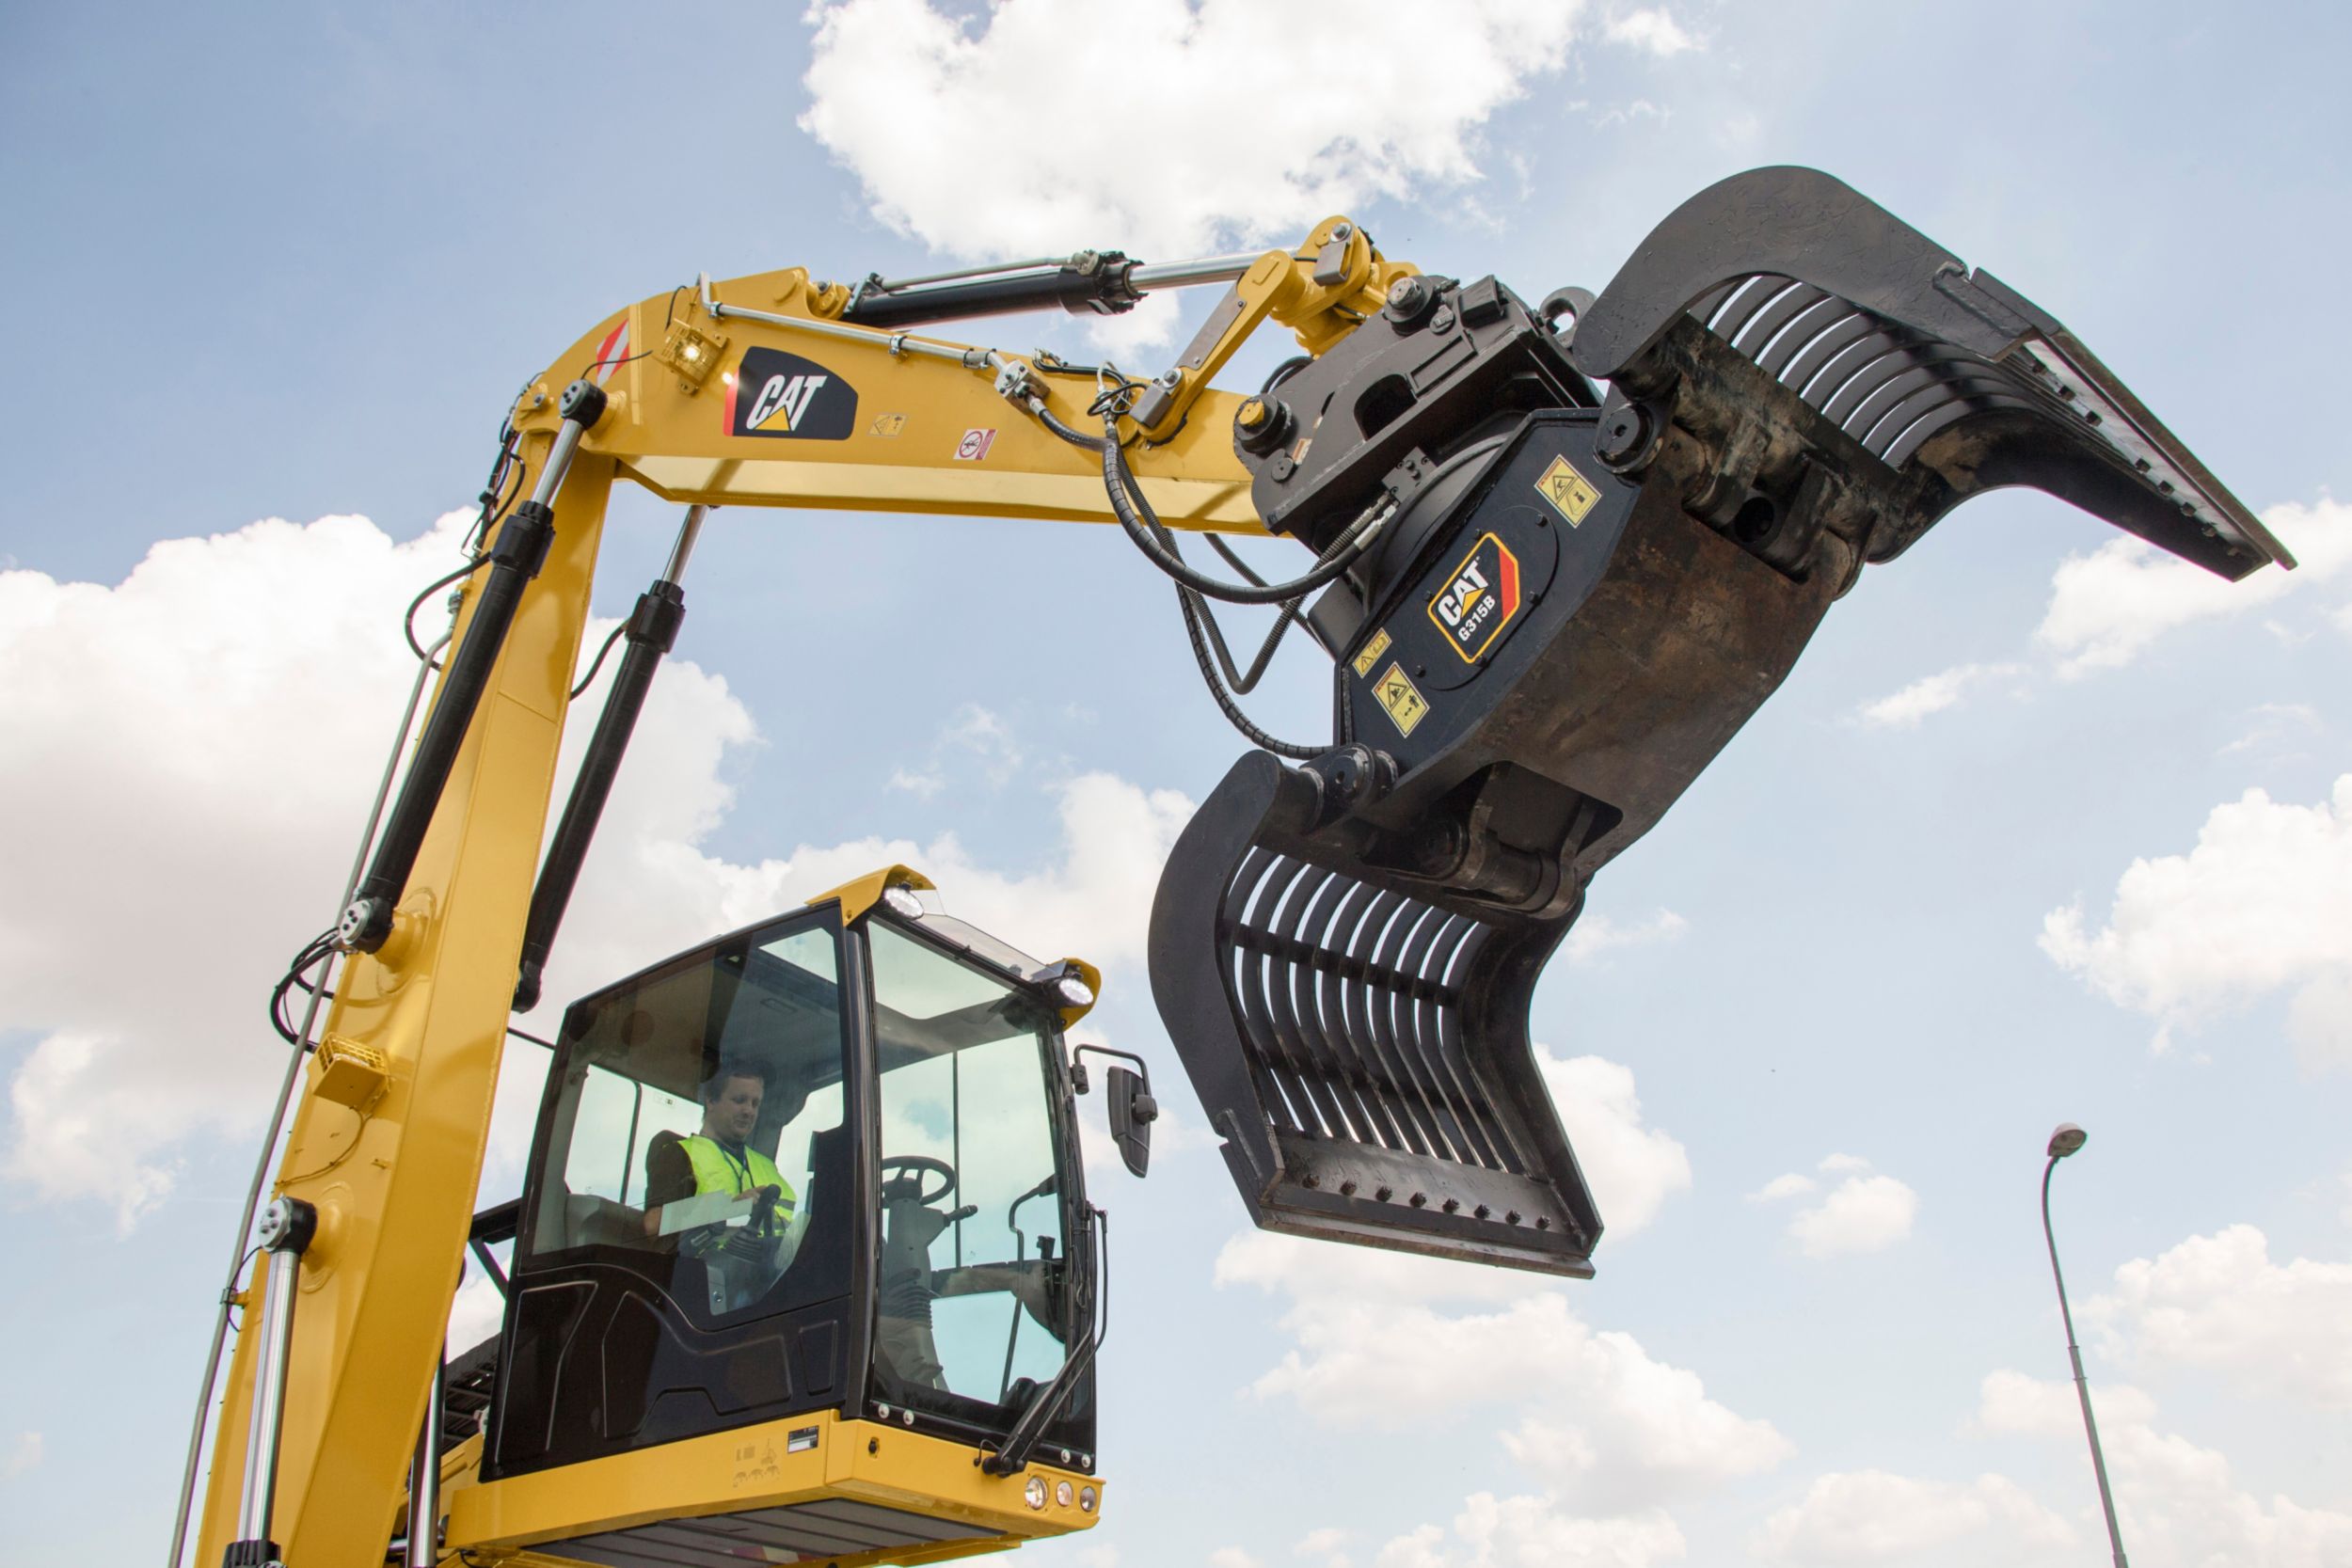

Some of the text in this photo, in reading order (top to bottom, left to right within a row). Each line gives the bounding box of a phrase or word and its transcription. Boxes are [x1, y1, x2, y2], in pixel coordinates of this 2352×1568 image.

[746, 374, 828, 431] CAT
[1438, 560, 1488, 626] CAT
[1457, 594, 1496, 641] G315B
